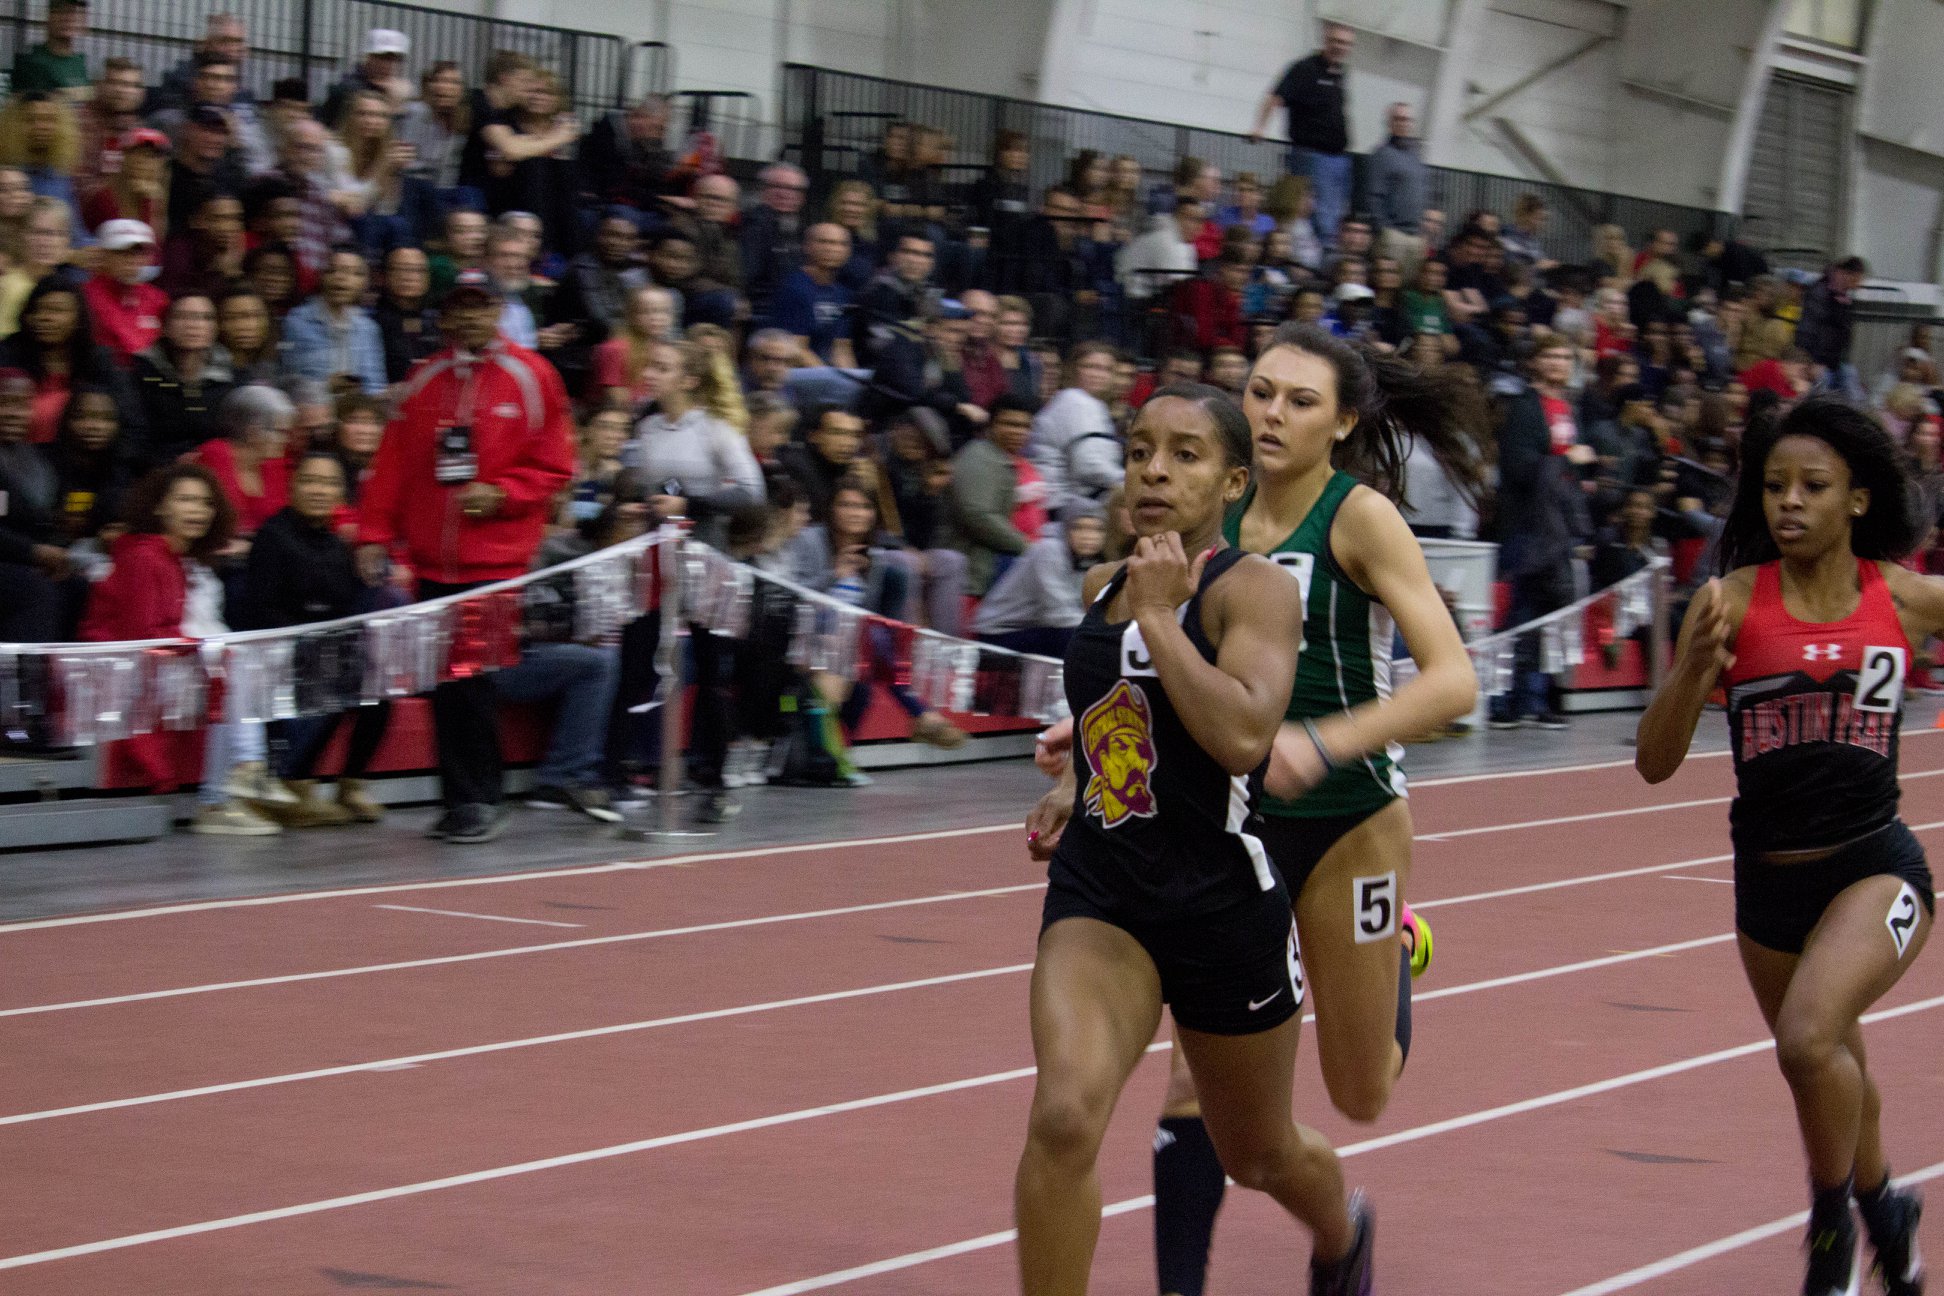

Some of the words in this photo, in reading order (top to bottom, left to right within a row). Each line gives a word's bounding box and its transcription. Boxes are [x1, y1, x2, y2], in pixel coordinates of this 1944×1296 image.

[1860, 651, 1895, 707] 2
[1741, 691, 1832, 762] AUSTIN
[1360, 878, 1391, 934] 5
[1890, 894, 1915, 949] 2
